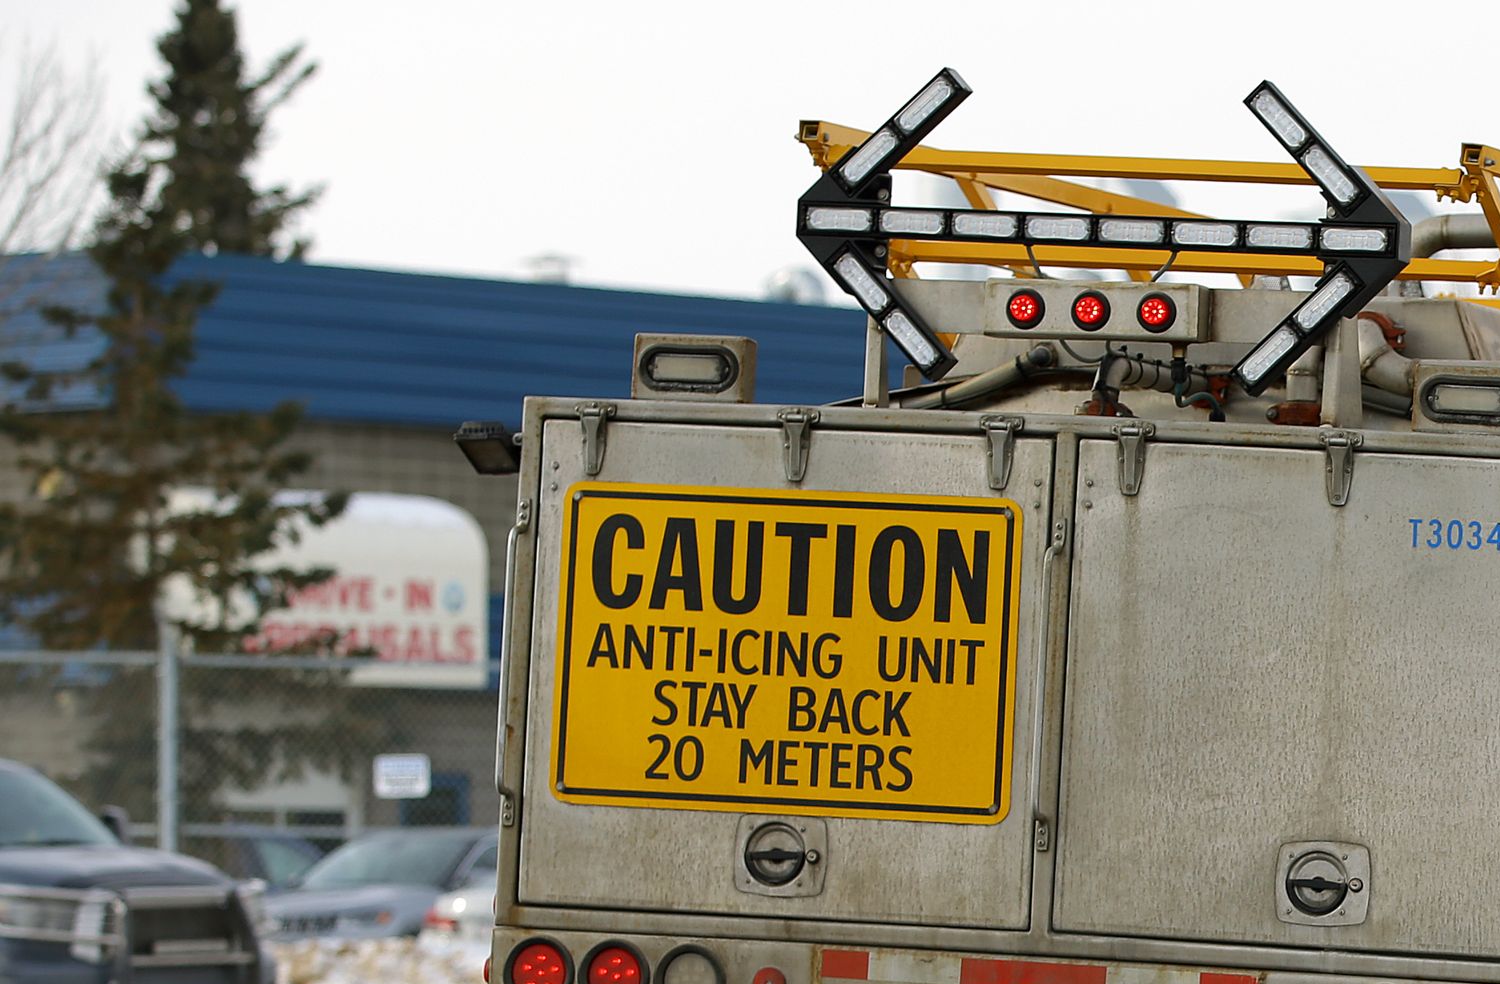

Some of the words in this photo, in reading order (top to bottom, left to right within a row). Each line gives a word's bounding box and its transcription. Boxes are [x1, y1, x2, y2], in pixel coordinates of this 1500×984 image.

[591, 513, 990, 625] CAUTION
[587, 623, 843, 680] ANTI-ICING
[878, 636, 985, 685] UNIT
[652, 680, 757, 730] STAY
[788, 686, 912, 737] BACK
[644, 734, 704, 782] 20
[738, 739, 914, 792] METERS
